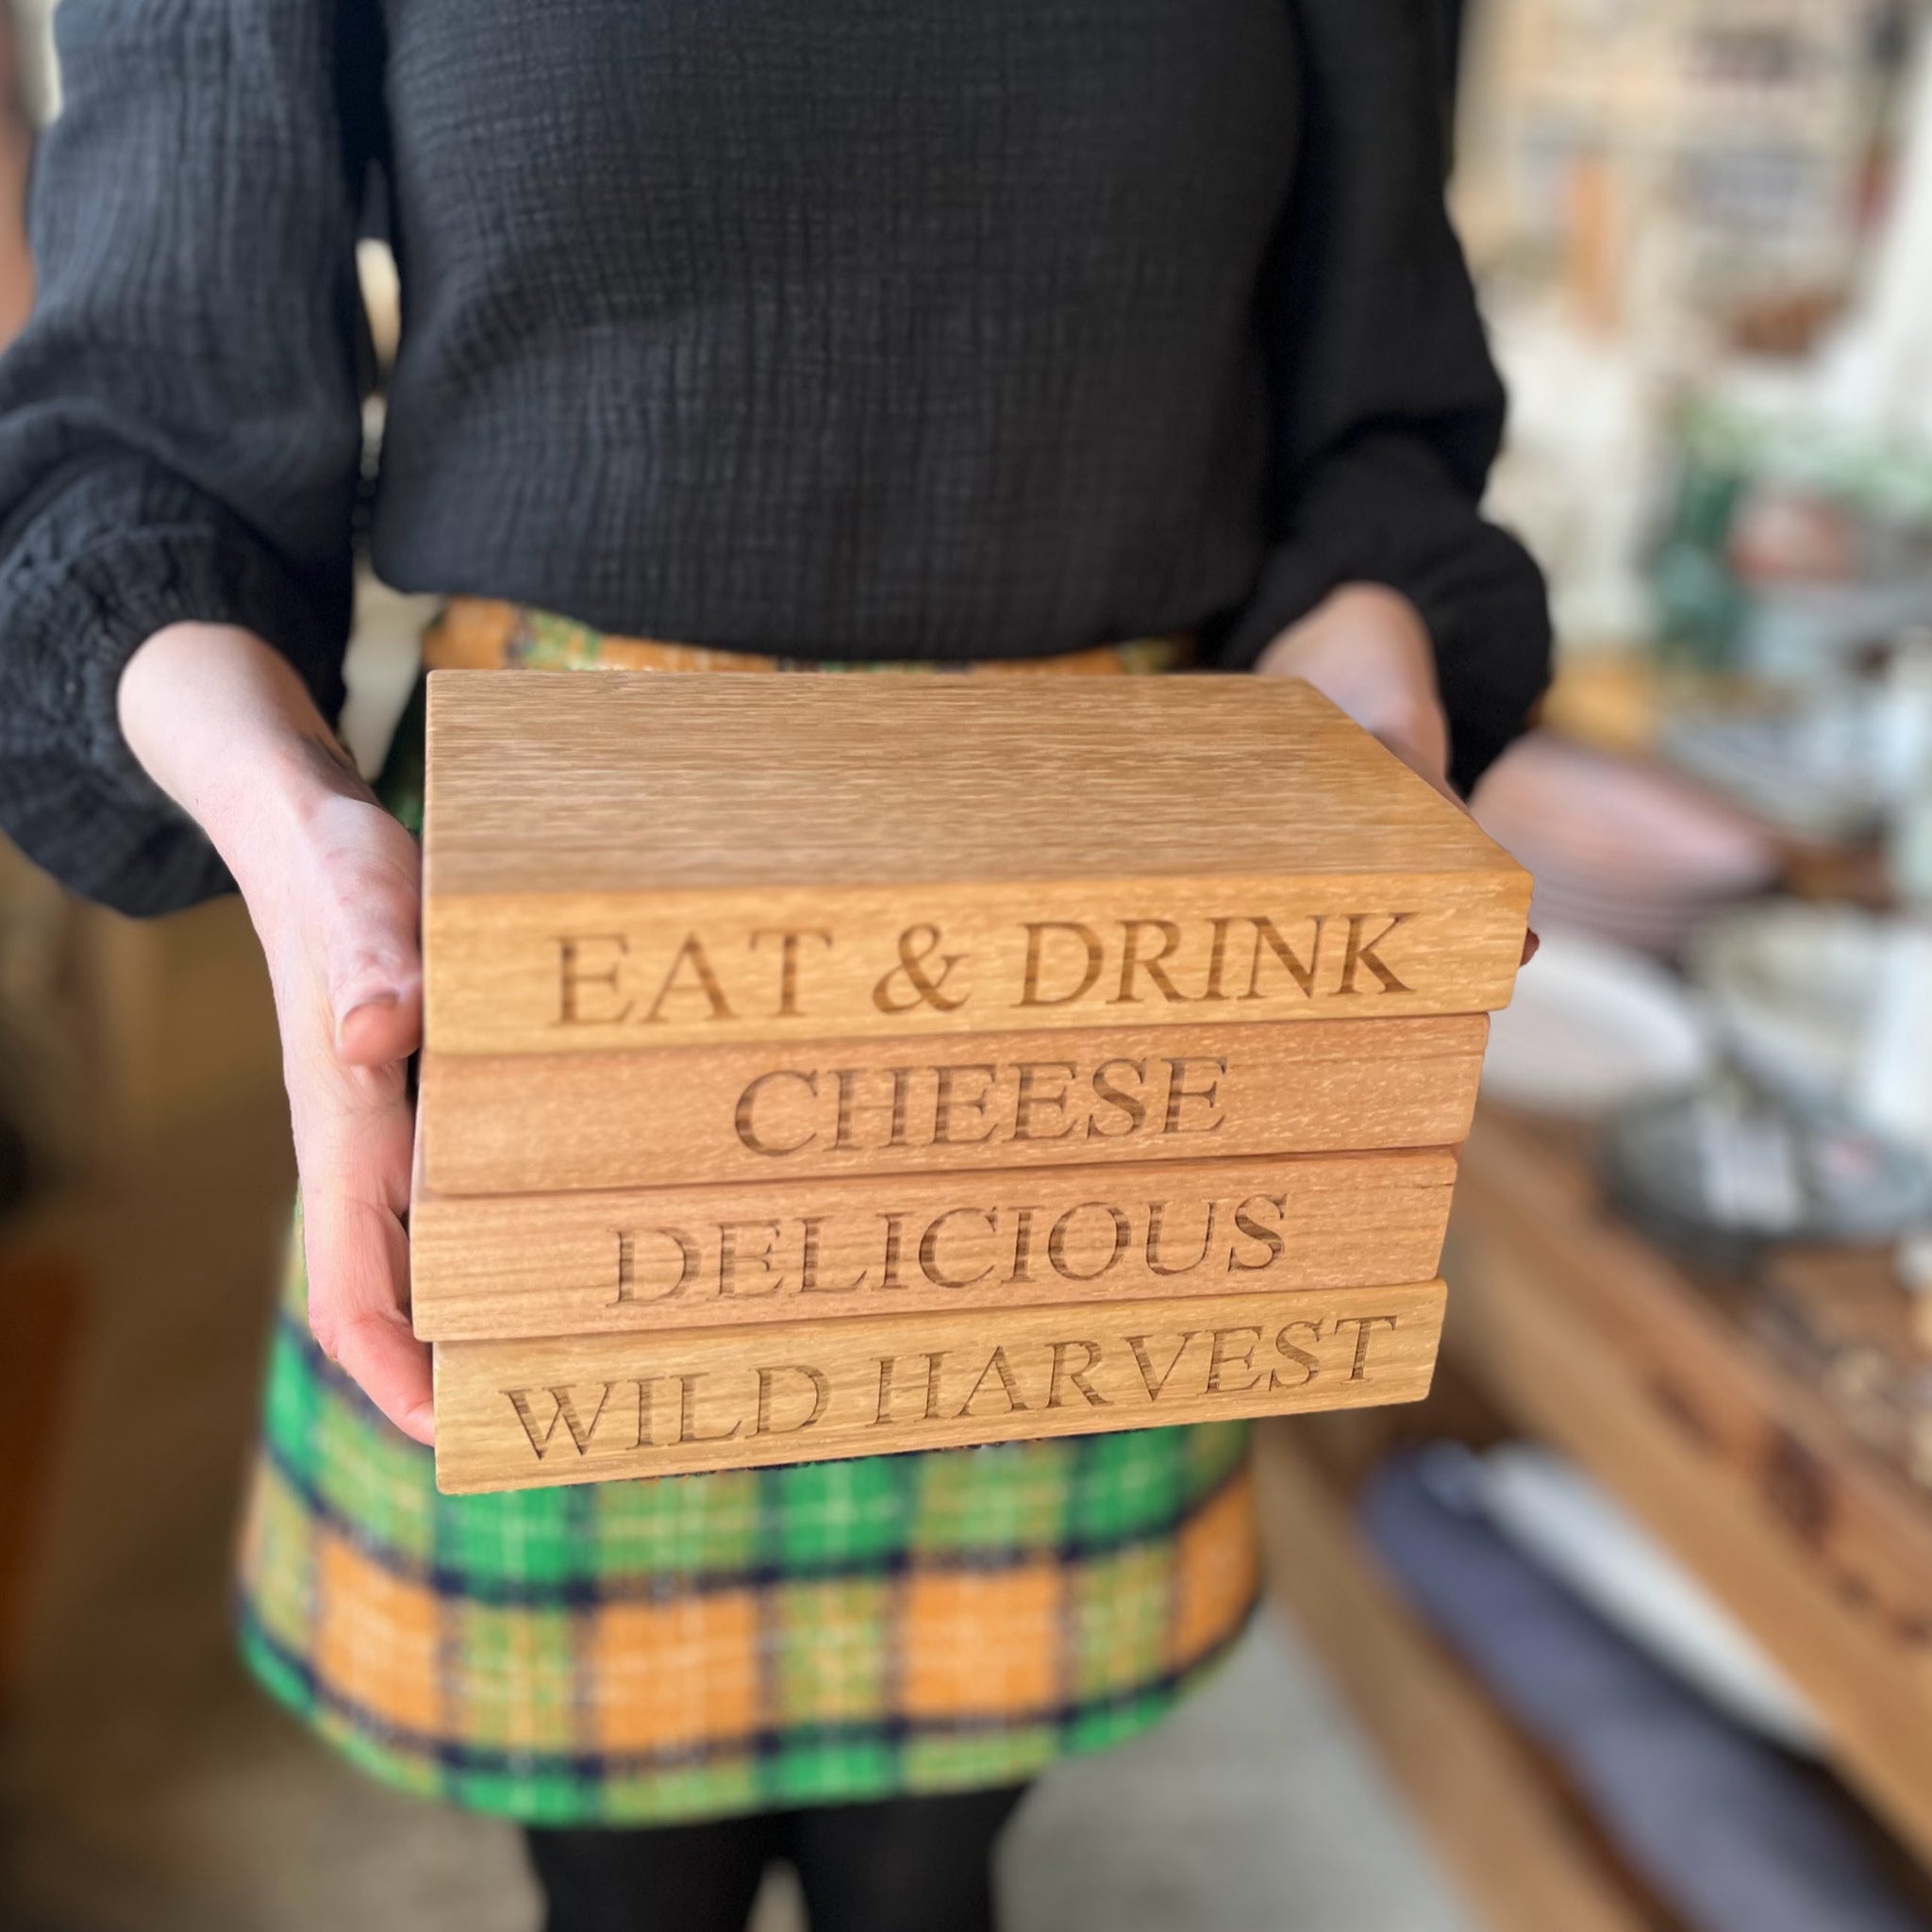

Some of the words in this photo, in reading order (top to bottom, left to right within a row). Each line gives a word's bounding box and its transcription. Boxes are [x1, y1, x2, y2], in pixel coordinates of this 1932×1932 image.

[552, 927, 832, 1026] EAT
[872, 922, 969, 1014] &
[1011, 911, 1421, 1008] DRINK
[734, 1055, 1228, 1158] CHEESE
[606, 1192, 1289, 1308] DELICIOUS
[500, 1364, 833, 1460] WILD
[863, 1315, 1398, 1428] HARVEST
